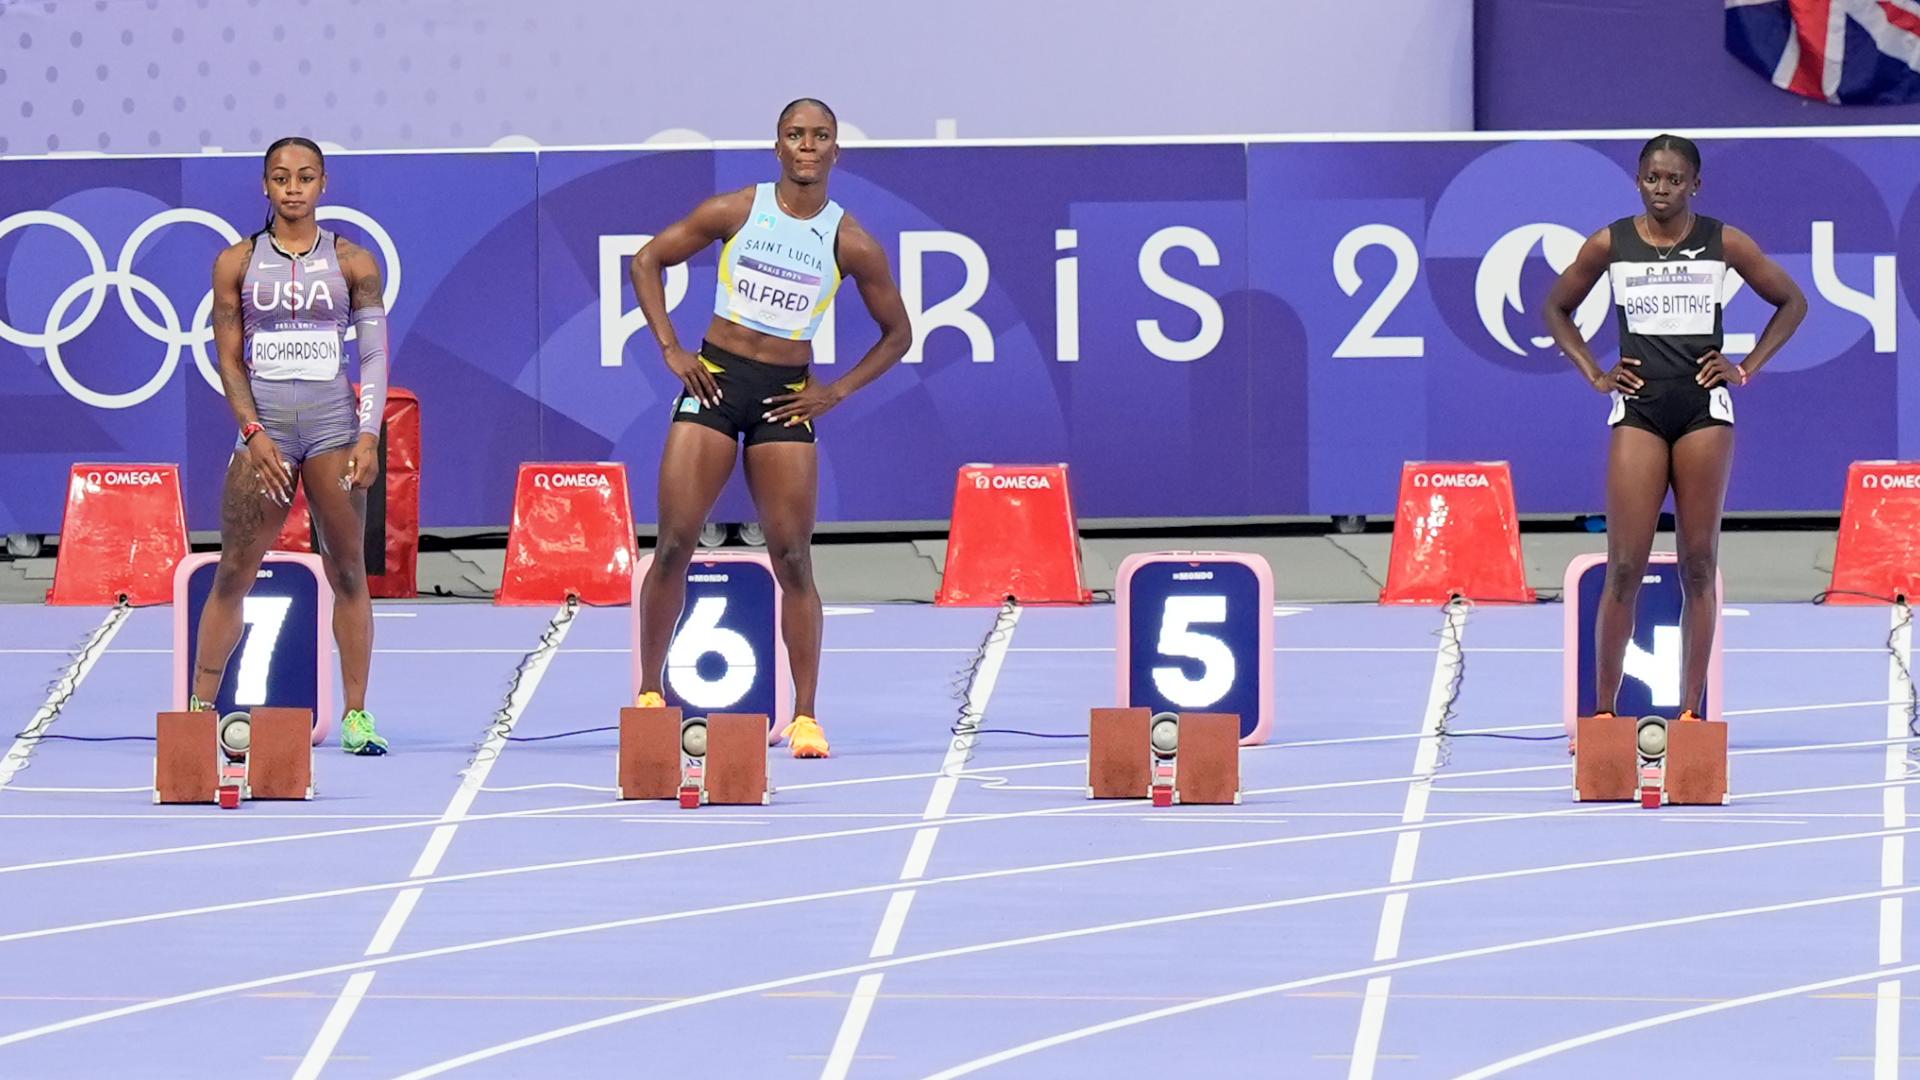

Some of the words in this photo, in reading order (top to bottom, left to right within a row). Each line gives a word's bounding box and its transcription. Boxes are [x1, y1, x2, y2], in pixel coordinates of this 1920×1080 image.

[744, 239, 783, 255] SAINT
[788, 247, 823, 273] LUCIA
[253, 280, 334, 311] USA
[737, 278, 810, 313] ALFRED
[1626, 295, 1659, 315] BASS
[1662, 295, 1712, 315] BITTAYE
[255, 341, 338, 361] RICHARDSON
[104, 471, 162, 486] OMEGA
[552, 473, 610, 487] OMEGA
[992, 475, 1051, 489] OMEGA
[1430, 473, 1490, 488] OMEGA
[235, 596, 293, 706] 7
[667, 596, 757, 708] 6
[1151, 595, 1236, 708] 5
[1622, 624, 1682, 707] 4
